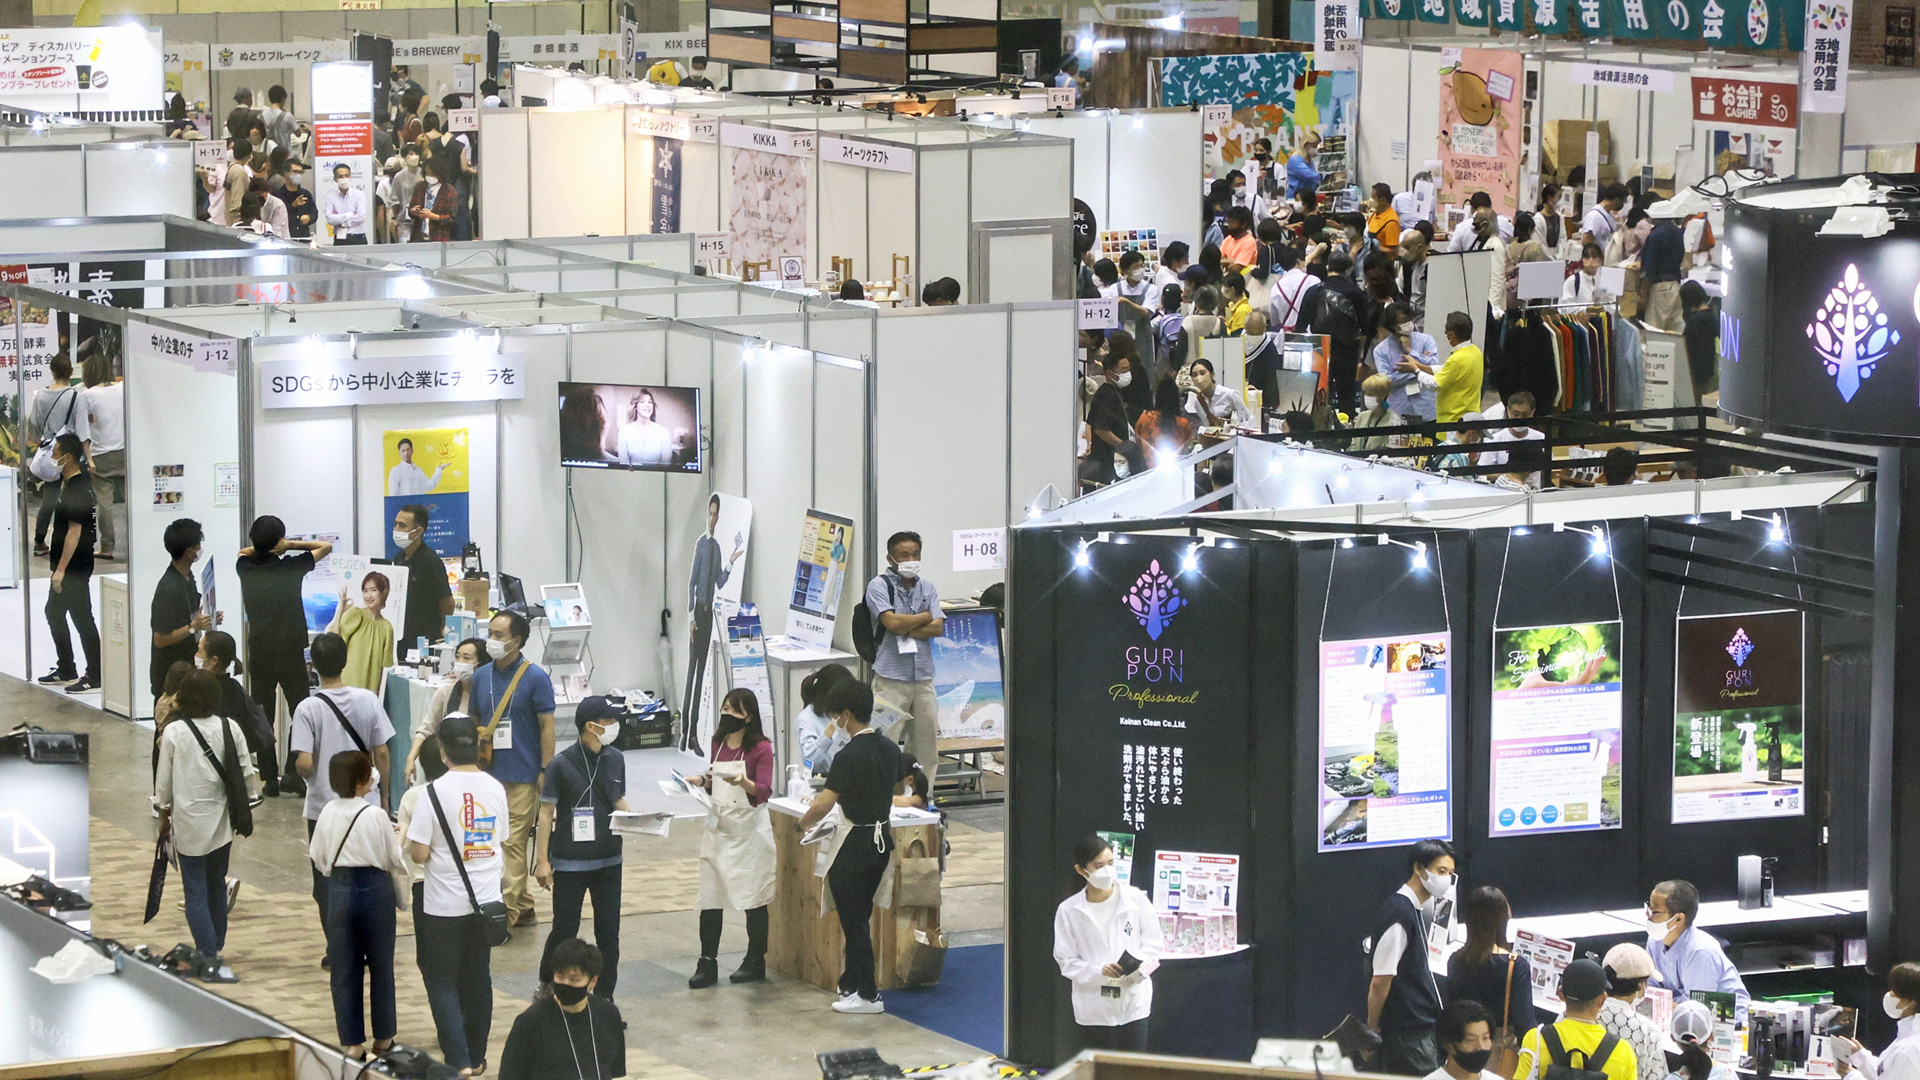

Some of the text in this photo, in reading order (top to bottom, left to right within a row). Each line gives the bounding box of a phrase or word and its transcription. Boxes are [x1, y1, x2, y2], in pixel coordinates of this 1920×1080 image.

[28, 41, 91, 51] ディスカバリー
[533, 43, 579, 54] 彦根麦酒
[665, 40, 682, 49] KIX
[239, 50, 321, 62] ぬとりブルーイング
[412, 46, 460, 56] BREWERY
[1813, 38, 1826, 91] 活用の会
[1824, 38, 1840, 92] 地域資源
[1593, 70, 1649, 86] 地域資源活用の会
[1053, 94, 1070, 103] E-18
[1722, 84, 1763, 110] お会計
[1209, 112, 1226, 121] E-17
[1725, 106, 1758, 119] CASHIER
[455, 115, 473, 124] F-18
[694, 125, 712, 134] F-17
[753, 132, 777, 147] KIKKA
[793, 139, 812, 148] F-16
[200, 148, 221, 157] H-17
[842, 146, 890, 165] スイーツクラフト
[700, 240, 724, 252] H-15
[1, 271, 27, 281] 9%OFF
[1085, 308, 1111, 319] H-12
[205, 349, 229, 361] J-12
[963, 542, 998, 557] H-08
[1125, 646, 1184, 666] GURI
[1508, 650, 1529, 667] For
[1127, 665, 1184, 684] PON
[1725, 669, 1752, 680] GURI
[1726, 678, 1752, 688] PON
[1109, 684, 1199, 709] Professional
[1120, 717, 1141, 726] Keinan
[1143, 719, 1161, 727] Clean
[1690, 717, 1703, 758] 新登場
[1148, 746, 1158, 803] 体にやさしく
[1160, 747, 1170, 805] 天ぷら油から
[1173, 747, 1183, 805] 使い終わった
[1123, 744, 1133, 826] 洗剤ができました。
[1135, 745, 1145, 831] 油汚れにすごい強い
